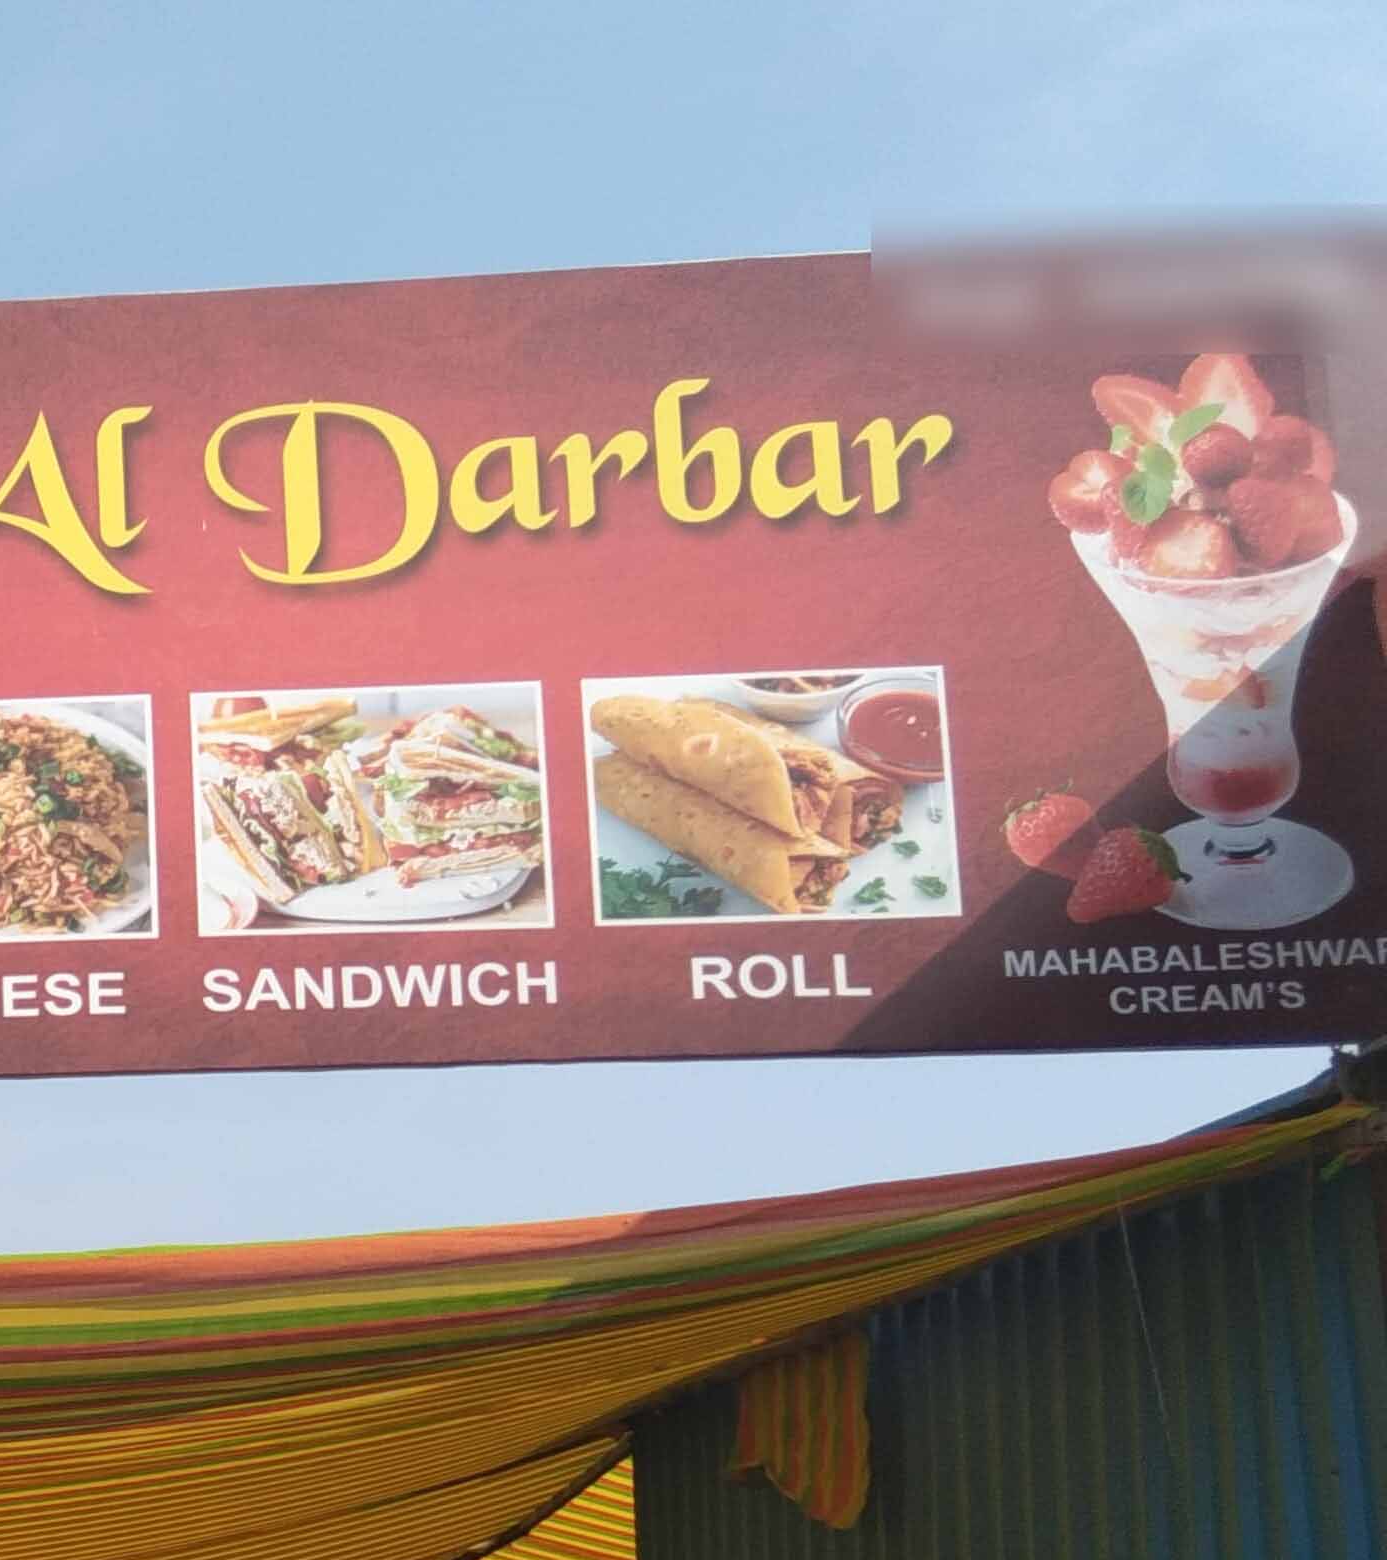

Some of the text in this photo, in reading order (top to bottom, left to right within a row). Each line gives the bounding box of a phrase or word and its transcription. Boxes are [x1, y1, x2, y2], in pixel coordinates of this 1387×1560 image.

[203, 380, 953, 585] Darbar
[202, 960, 558, 1012] SANDWICH
[690, 953, 872, 1000] ROLL
[1109, 981, 1306, 1015] CREAM'S
